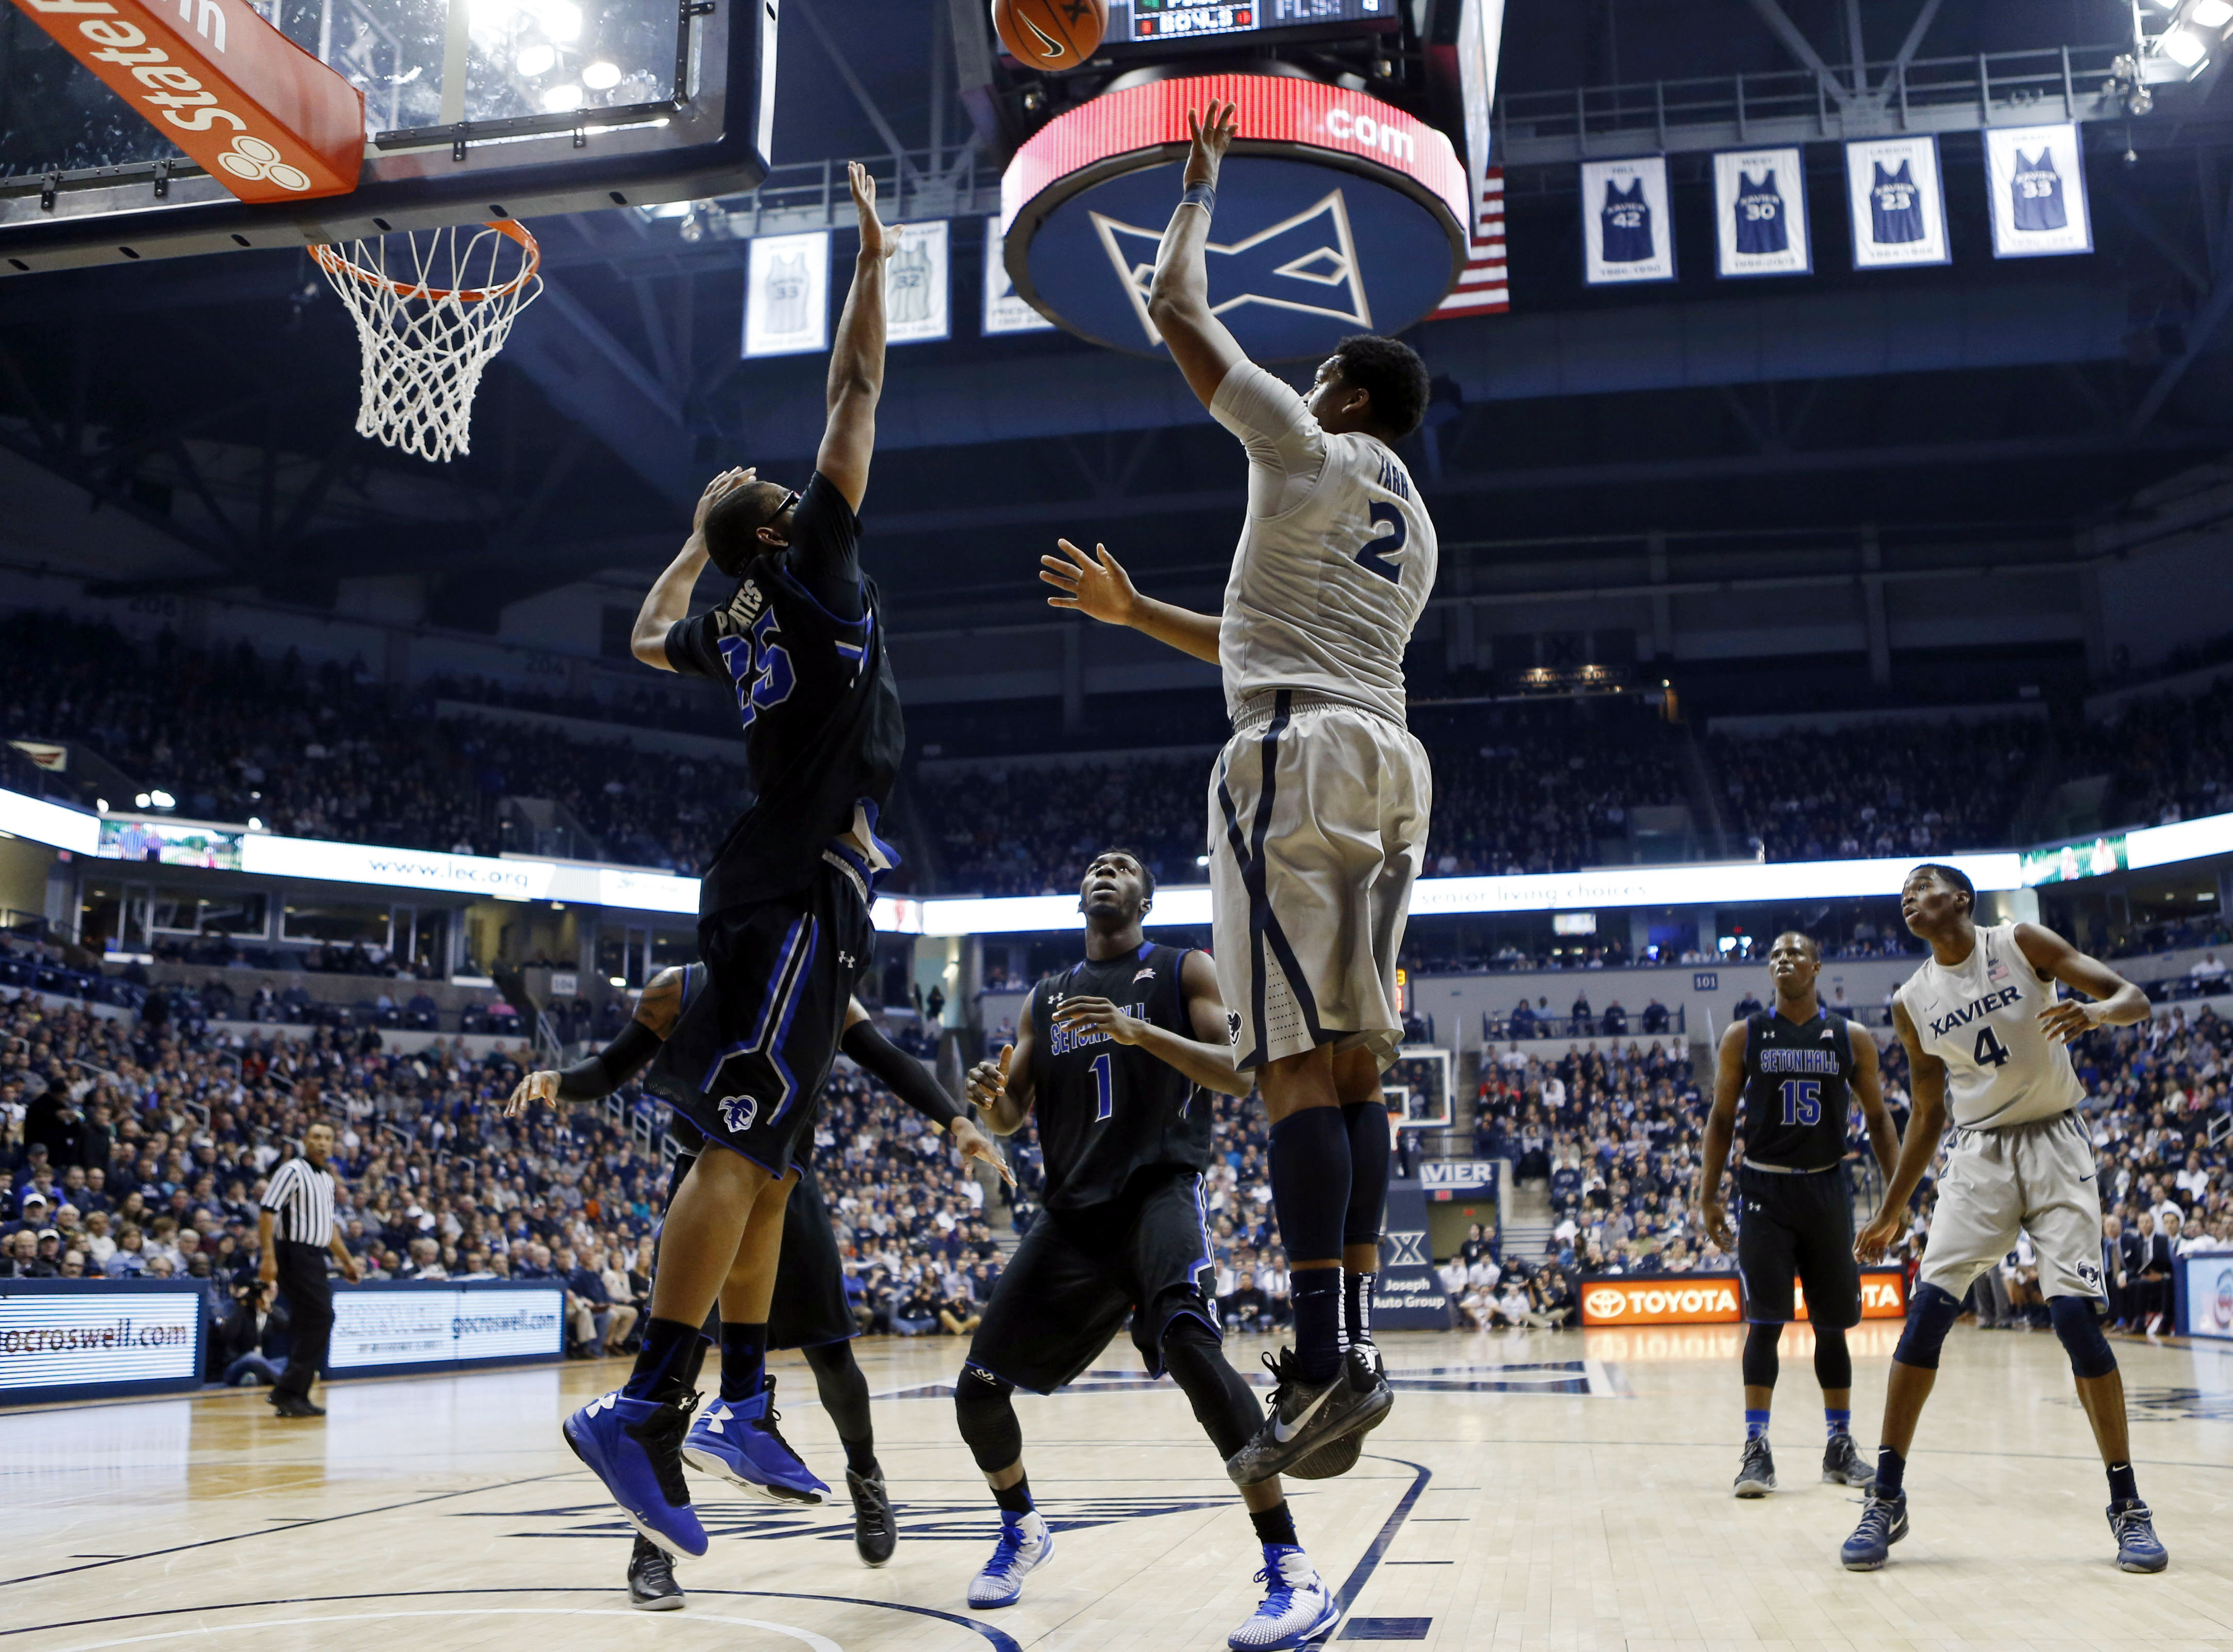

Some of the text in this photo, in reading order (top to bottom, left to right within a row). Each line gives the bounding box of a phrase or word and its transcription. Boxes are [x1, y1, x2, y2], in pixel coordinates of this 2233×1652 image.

[78, 18, 247, 132] State
[1881, 192, 1911, 211] 23
[2022, 180, 2053, 198] 33
[1612, 212, 1641, 228] 42
[1746, 203, 1775, 221] 30
[1354, 498, 1409, 586] 2
[717, 604, 797, 730] 25
[1697, 976, 1716, 988] 101
[1929, 985, 2024, 1040] XAVIER
[1974, 1025, 2012, 1068] 4
[1760, 1049, 1840, 1075] SETON HALL
[1088, 1053, 1112, 1122] 1
[1778, 1080, 1821, 1125] 15
[1385, 1277, 1431, 1293] Joseph
[1373, 1294, 1446, 1310] Auto Group
[1628, 1288, 1738, 1314] TOYOTA
